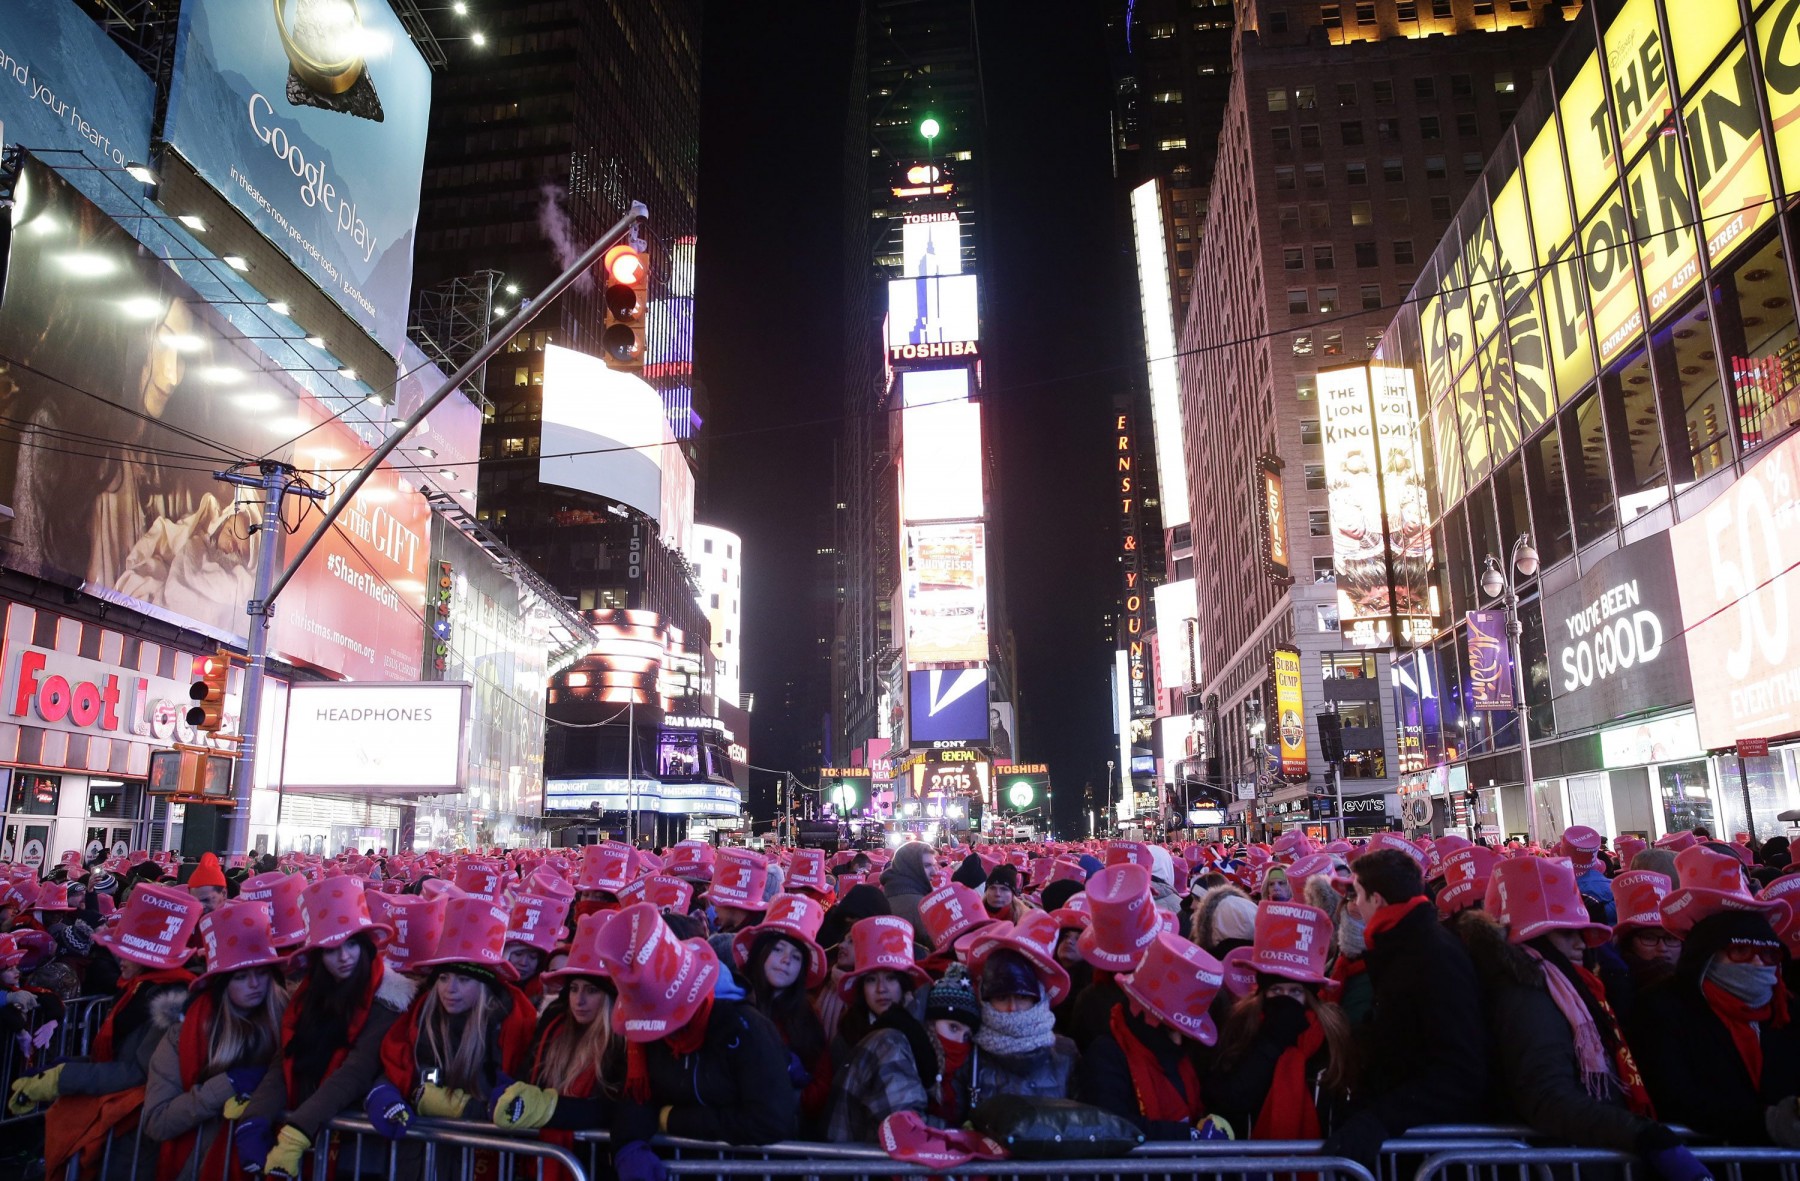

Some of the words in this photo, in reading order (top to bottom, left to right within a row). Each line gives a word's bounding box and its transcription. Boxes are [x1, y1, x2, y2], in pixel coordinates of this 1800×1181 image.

[1590, 29, 1666, 161] THE
[30, 77, 70, 117] your
[71, 106, 111, 157] heart
[112, 148, 134, 170] ou
[249, 93, 336, 213] Google
[338, 198, 377, 263] play
[904, 211, 957, 224] TOSHIBA
[230, 164, 240, 183] in
[239, 174, 271, 213] theaters
[271, 206, 290, 233] now,
[289, 226, 321, 262] pre-order
[320, 255, 339, 282] today
[344, 281, 377, 319] g.co/hobbit
[1548, 174, 1652, 360] LION
[1602, 310, 1641, 356] ENTRANCE
[1651, 287, 1667, 309] ON
[1671, 260, 1697, 289] 45TH
[1708, 214, 1745, 257] STREET
[890, 341, 978, 360] TOSHIBA
[1329, 387, 1356, 400] THE
[1326, 404, 1363, 422] LION
[1325, 424, 1369, 444] KING
[1117, 415, 1132, 513] ERNST
[356, 492, 368, 515] IS
[348, 508, 371, 544] THE
[372, 506, 420, 574] GIFT
[1124, 535, 1137, 550] &
[628, 524, 640, 579] 1500
[327, 553, 399, 613] #ShareTheGift
[439, 563, 452, 616] TOYS
[1566, 599, 1602, 640] YOU'VE
[1600, 579, 1640, 619] BEEN
[1126, 572, 1144, 681] YOUNG
[290, 612, 376, 664] christmas.mormon.org
[1562, 640, 1594, 691] SO
[1595, 610, 1663, 680] GOOD
[1276, 656, 1299, 672] BUBBA
[1279, 672, 1298, 687] GUMP
[10, 650, 121, 731] Foot
[316, 708, 432, 721] HEADPHONES
[664, 714, 685, 727] STAR
[686, 716, 712, 729] WARS
[933, 740, 966, 748] SONY
[941, 750, 977, 762] GENERAL
[997, 763, 1048, 774] TOSHIBA
[931, 774, 971, 789] 2015
[1618, 874, 1667, 888] COVERGIRL
[141, 893, 189, 914] COVERGIRL
[1266, 904, 1318, 921] COSMOPOLITAN
[166, 915, 184, 927] HAPPY
[1296, 923, 1314, 936] HAPPY
[121, 933, 172, 956] COSMOPOLITAN
[1295, 940, 1309, 952] YEAR
[1260, 949, 1310, 966] COVERGIRL
